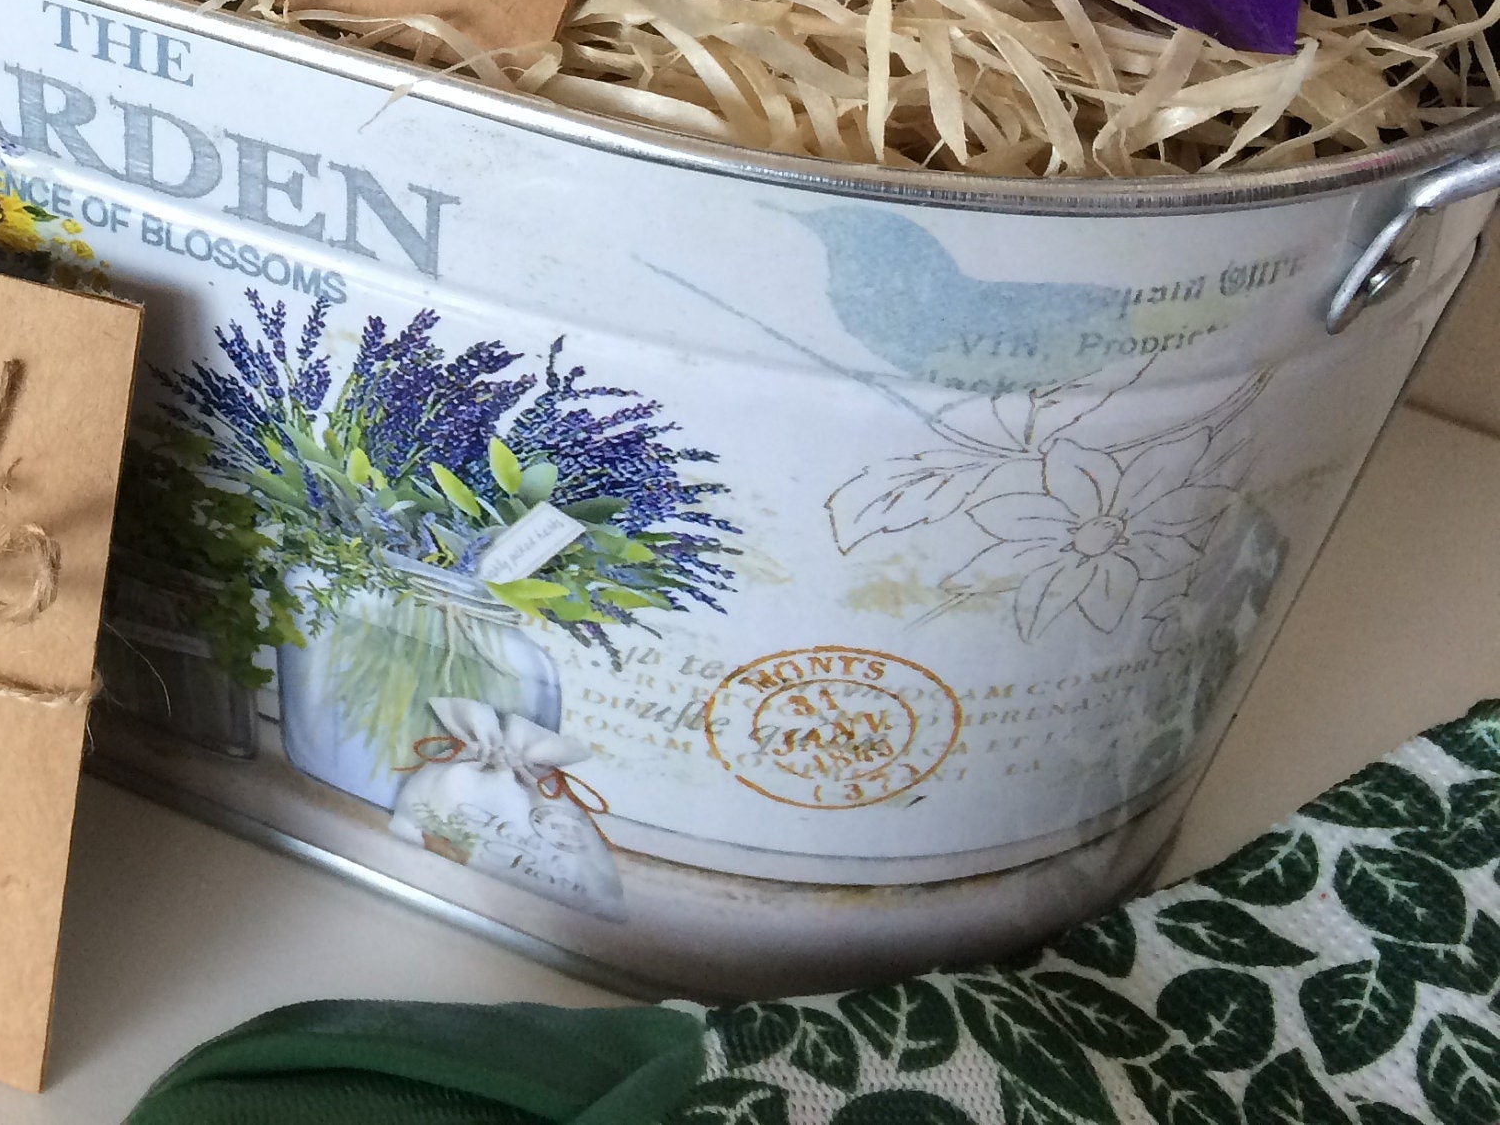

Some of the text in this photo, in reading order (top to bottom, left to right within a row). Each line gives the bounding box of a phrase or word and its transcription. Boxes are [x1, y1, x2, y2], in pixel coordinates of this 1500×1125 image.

[42, 0, 195, 87] THE
[81, 195, 132, 233] OF
[140, 211, 349, 305] BLOSSOMS
